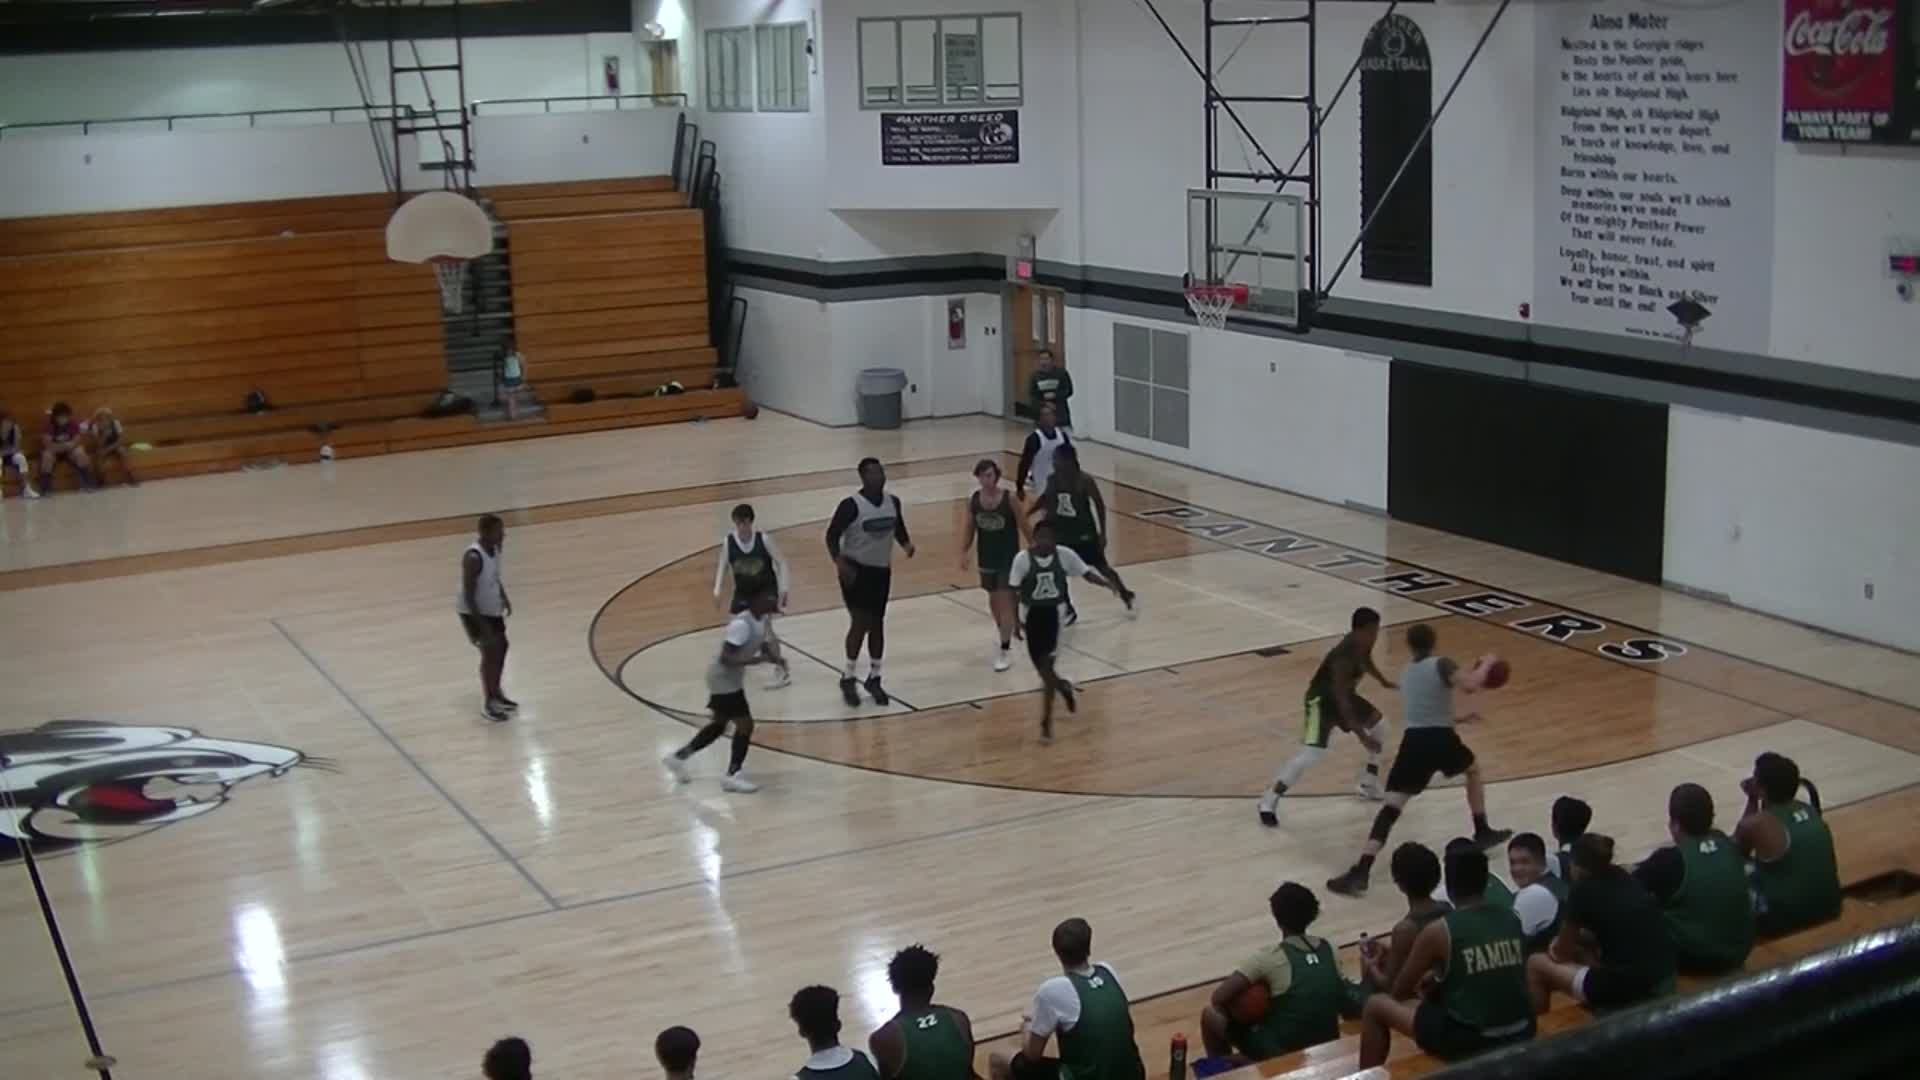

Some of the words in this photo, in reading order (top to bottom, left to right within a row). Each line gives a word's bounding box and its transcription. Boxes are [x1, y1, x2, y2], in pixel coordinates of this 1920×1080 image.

[1590, 13, 1623, 30] Alma
[1628, 12, 1669, 30] Mater
[1614, 40, 1628, 49] the
[1634, 40, 1670, 51] Georgia
[1675, 40, 1704, 52] ridges
[1359, 56, 1429, 72] BASKETBALL
[1573, 56, 1598, 66] Rests
[1602, 56, 1616, 65] the
[1620, 56, 1654, 66] Panther
[1574, 72, 1587, 81] the
[1593, 72, 1622, 82] hearts
[1627, 72, 1638, 81] of
[1643, 72, 1654, 81] all
[1662, 72, 1680, 82] who
[1686, 72, 1710, 82] learn
[1716, 72, 1738, 82] here
[1573, 86, 1591, 96] Lies
[1616, 87, 1660, 100] Ridgeland
[896, 114, 957, 123] PANTHER
[960, 112, 1004, 122] CREED
[1560, 106, 1601, 118] Ridgeland
[1648, 108, 1693, 120] Ridgeland
[1785, 111, 1835, 124] ALWAYS
[1836, 111, 1871, 124] PART
[1872, 112, 1890, 127] OF
[1572, 122, 1595, 132] From
[1798, 125, 1830, 139] YOUR
[1832, 126, 1872, 140] TEAM!
[1560, 135, 1575, 146] The
[1581, 137, 1605, 147] torch
[1610, 139, 1620, 148] of
[1712, 144, 1730, 154] and
[1560, 166, 1585, 178] Burns
[1590, 168, 1618, 180] within
[1622, 172, 1637, 182] our
[1560, 185, 1582, 198] Deep
[1587, 188, 1614, 199] within
[1620, 192, 1633, 200] our
[1640, 192, 1663, 202] souls
[1696, 195, 1732, 208] cherish
[1572, 200, 1617, 212] memories
[1650, 205, 1677, 217] made
[1560, 210, 1571, 222] Of
[1575, 212, 1589, 224] the
[1594, 216, 1626, 230] mighty
[1631, 218, 1670, 232] Panther
[1674, 221, 1705, 234] Power
[1572, 228, 1592, 240] That
[1598, 230, 1615, 242] will
[1620, 235, 1646, 245] never
[1650, 236, 1676, 248] fade.
[1560, 246, 1597, 264] Loyalty,
[1601, 250, 1632, 264] honor,
[1634, 254, 1662, 268] trust,
[1667, 258, 1684, 269] and
[1690, 260, 1716, 272] spirit
[1571, 262, 1586, 273] All
[1590, 264, 1615, 278] begin
[1560, 275, 1573, 288] We
[1578, 278, 1592, 289] will
[1597, 280, 1614, 292] love
[1618, 283, 1633, 294] the
[1638, 284, 1663, 298] Black
[1668, 290, 1686, 300] and
[1690, 290, 1718, 304] Silver
[1571, 291, 1589, 304] True
[1594, 295, 1614, 308] until
[1618, 298, 1632, 310] the
[1056, 492, 1077, 518] A
[1031, 571, 1060, 600] A
[1136, 504, 1688, 663] PANTHERS
[1461, 938, 1522, 975] FAMILY
[915, 1012, 938, 1029] 22
